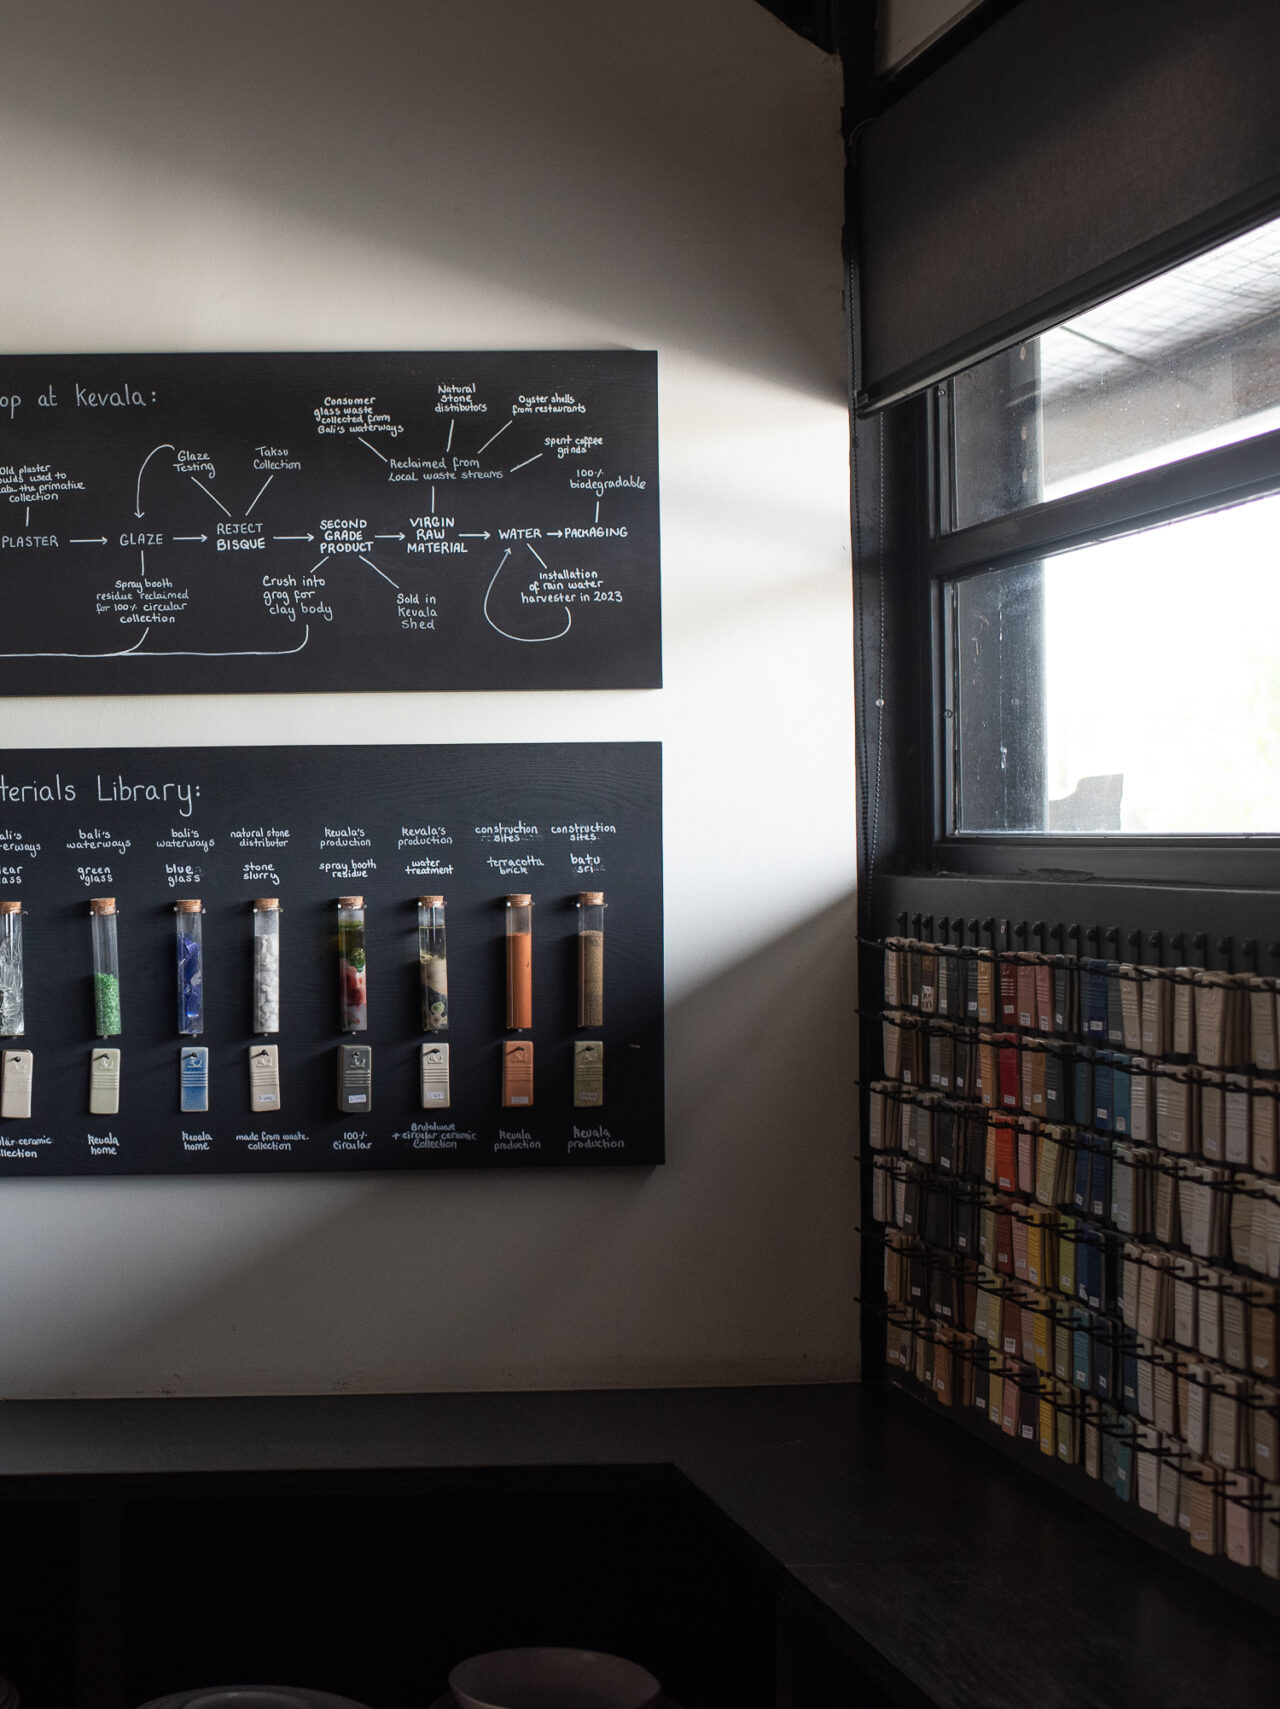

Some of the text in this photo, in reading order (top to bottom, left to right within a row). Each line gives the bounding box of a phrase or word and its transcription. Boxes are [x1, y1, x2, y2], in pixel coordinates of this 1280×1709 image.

[438, 383, 476, 394] Natural
[38, 385, 58, 407] at
[324, 397, 376, 406] Consumer
[440, 393, 472, 403] stone
[519, 393, 574, 405] Oyster shells
[435, 402, 487, 413] distributors
[512, 404, 586, 415] from restaurants
[314, 407, 373, 421] glass waste
[321, 414, 391, 423] collected from
[349, 424, 404, 437] waterways
[544, 435, 603, 448] spent coffee
[177, 449, 211, 462] Glaze
[255, 447, 288, 456] Taksu
[557, 446, 587, 458] grinds
[173, 461, 215, 478] Testing
[390, 458, 479, 469] Reclaimed from
[18, 464, 51, 478] plaster
[30, 473, 52, 482] used
[54, 470, 67, 480] to
[423, 472, 456, 480] waste
[460, 470, 504, 480] streams
[18, 482, 37, 493] the
[39, 480, 86, 491] primative
[570, 475, 646, 496] biodegradable
[217, 523, 263, 534] REJECT
[320, 519, 367, 529] SECOND
[410, 517, 454, 528] VIRGIN
[324, 531, 363, 541] GRADE
[416, 529, 445, 539] RAW
[498, 529, 542, 540] WATER
[564, 527, 628, 539] PACKAGING
[1, 535, 59, 548] PLASTER
[120, 533, 163, 546] GLAZE
[217, 538, 266, 551] BISQUE
[320, 541, 374, 553] PRODUCT
[407, 542, 468, 553] MATERIAL
[144, 578, 173, 588] booth
[263, 575, 325, 587] Crush into
[529, 579, 603, 592] of rain water
[96, 590, 189, 600] residue reclaimed
[263, 590, 315, 606] grog for
[397, 594, 436, 604] Sold in
[521, 590, 623, 603] harvester in 2023
[96, 603, 112, 614] for
[143, 601, 188, 611] circular
[269, 602, 333, 621] clay body
[97, 774, 202, 817] Library:
[171, 829, 199, 839] bali's
[230, 828, 290, 839] natural stone
[474, 821, 538, 835] construction
[551, 822, 616, 834] construction
[78, 829, 110, 840] bali's
[493, 833, 520, 843] sites
[570, 832, 597, 841] sites
[66, 838, 131, 854] waterways
[156, 838, 215, 853] waterways
[239, 838, 288, 848] distributor
[320, 837, 371, 849] production
[398, 836, 453, 849] production
[411, 859, 440, 868] water
[487, 855, 544, 868] terracotta
[570, 854, 601, 865] batu
[77, 865, 111, 879] green
[165, 864, 194, 874] blue
[243, 862, 274, 872] stone
[319, 859, 376, 873] spray booth
[406, 865, 454, 875] treatment
[499, 865, 528, 875] brick
[84, 873, 114, 884] glass
[243, 872, 280, 885] slurry
[332, 869, 368, 878] residue
[168, 873, 201, 887] glass
